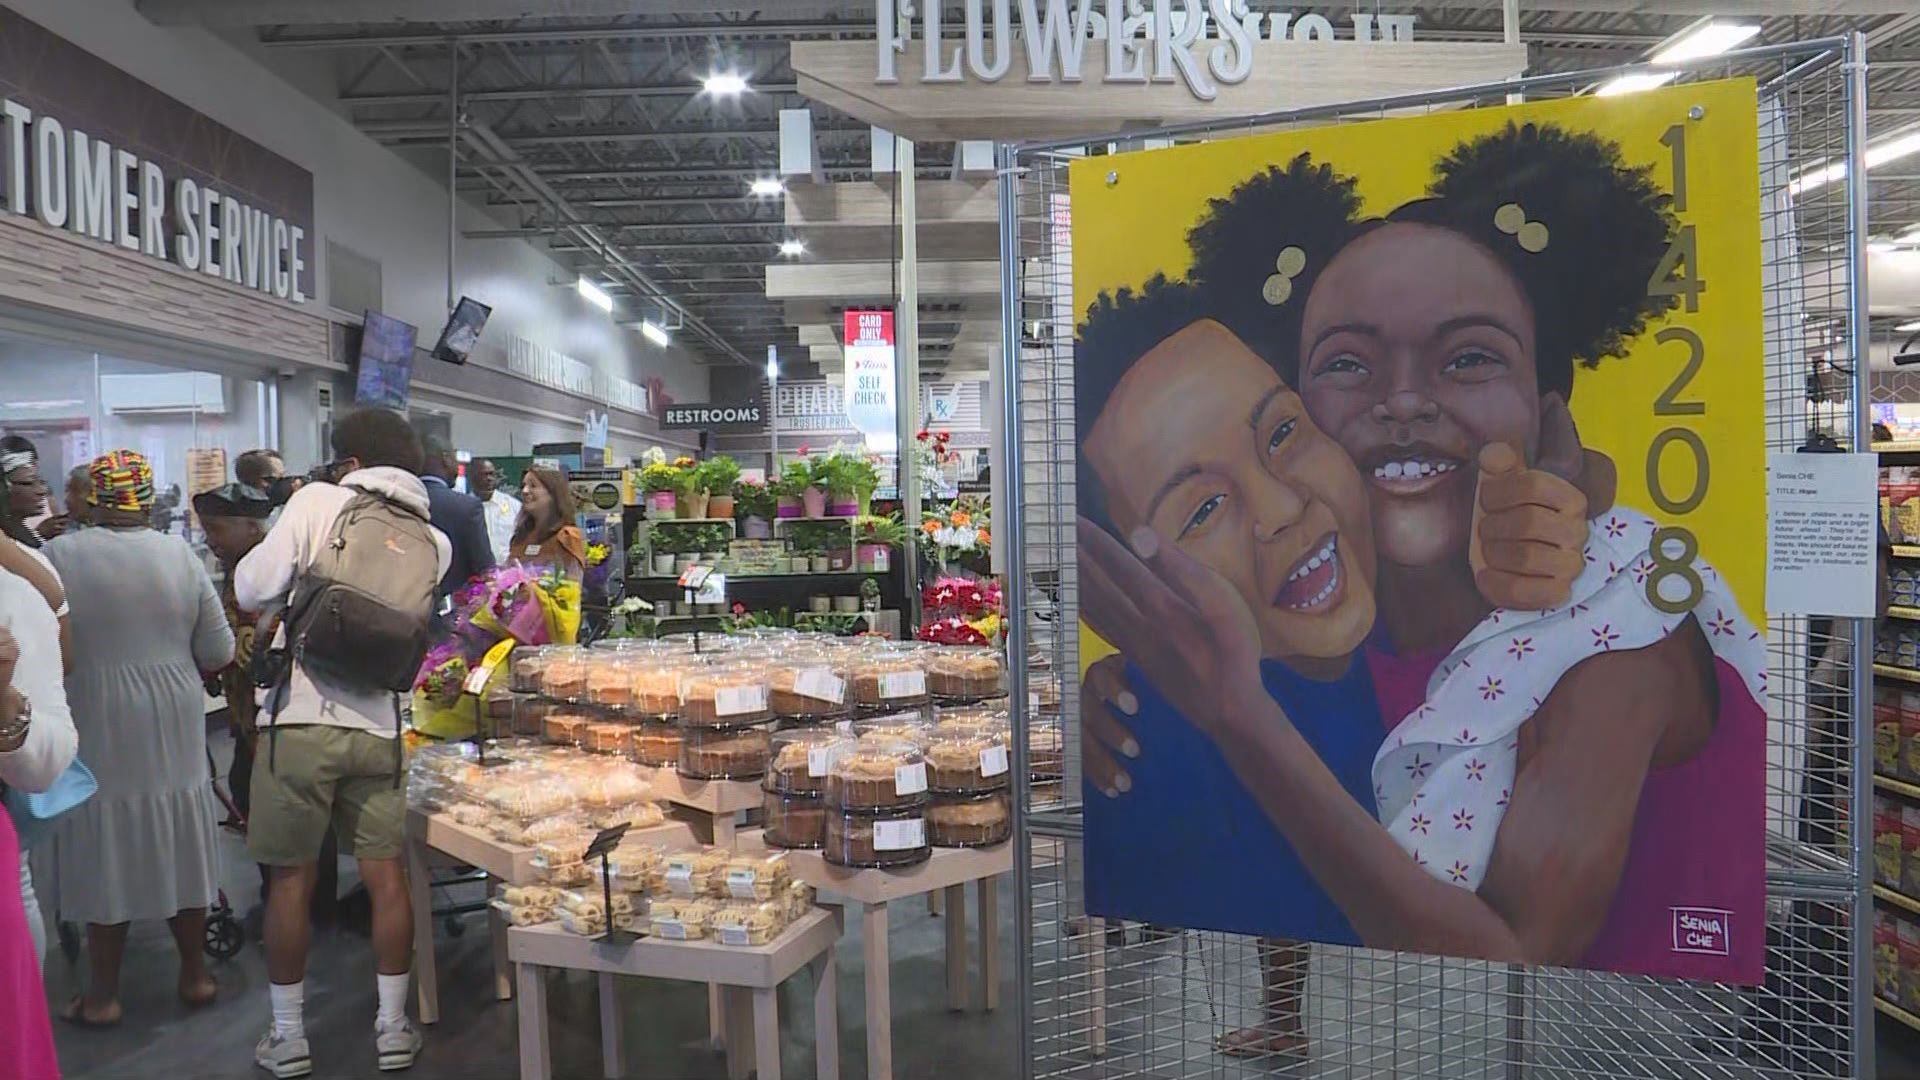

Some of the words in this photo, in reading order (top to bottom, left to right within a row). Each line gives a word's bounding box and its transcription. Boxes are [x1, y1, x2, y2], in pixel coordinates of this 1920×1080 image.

[874, 0, 1252, 101] FLOWERS
[174, 178, 305, 303] SERVICE
[859, 314, 882, 327] CARD
[860, 327, 882, 340] ONLY
[858, 375, 881, 390] SELF
[854, 391, 887, 405] CHECK
[666, 408, 760, 424] RESTROOMS
[790, 417, 826, 430] TRUSTED
[1680, 912, 1722, 934] SENIA
[1686, 931, 1713, 947] CHE
